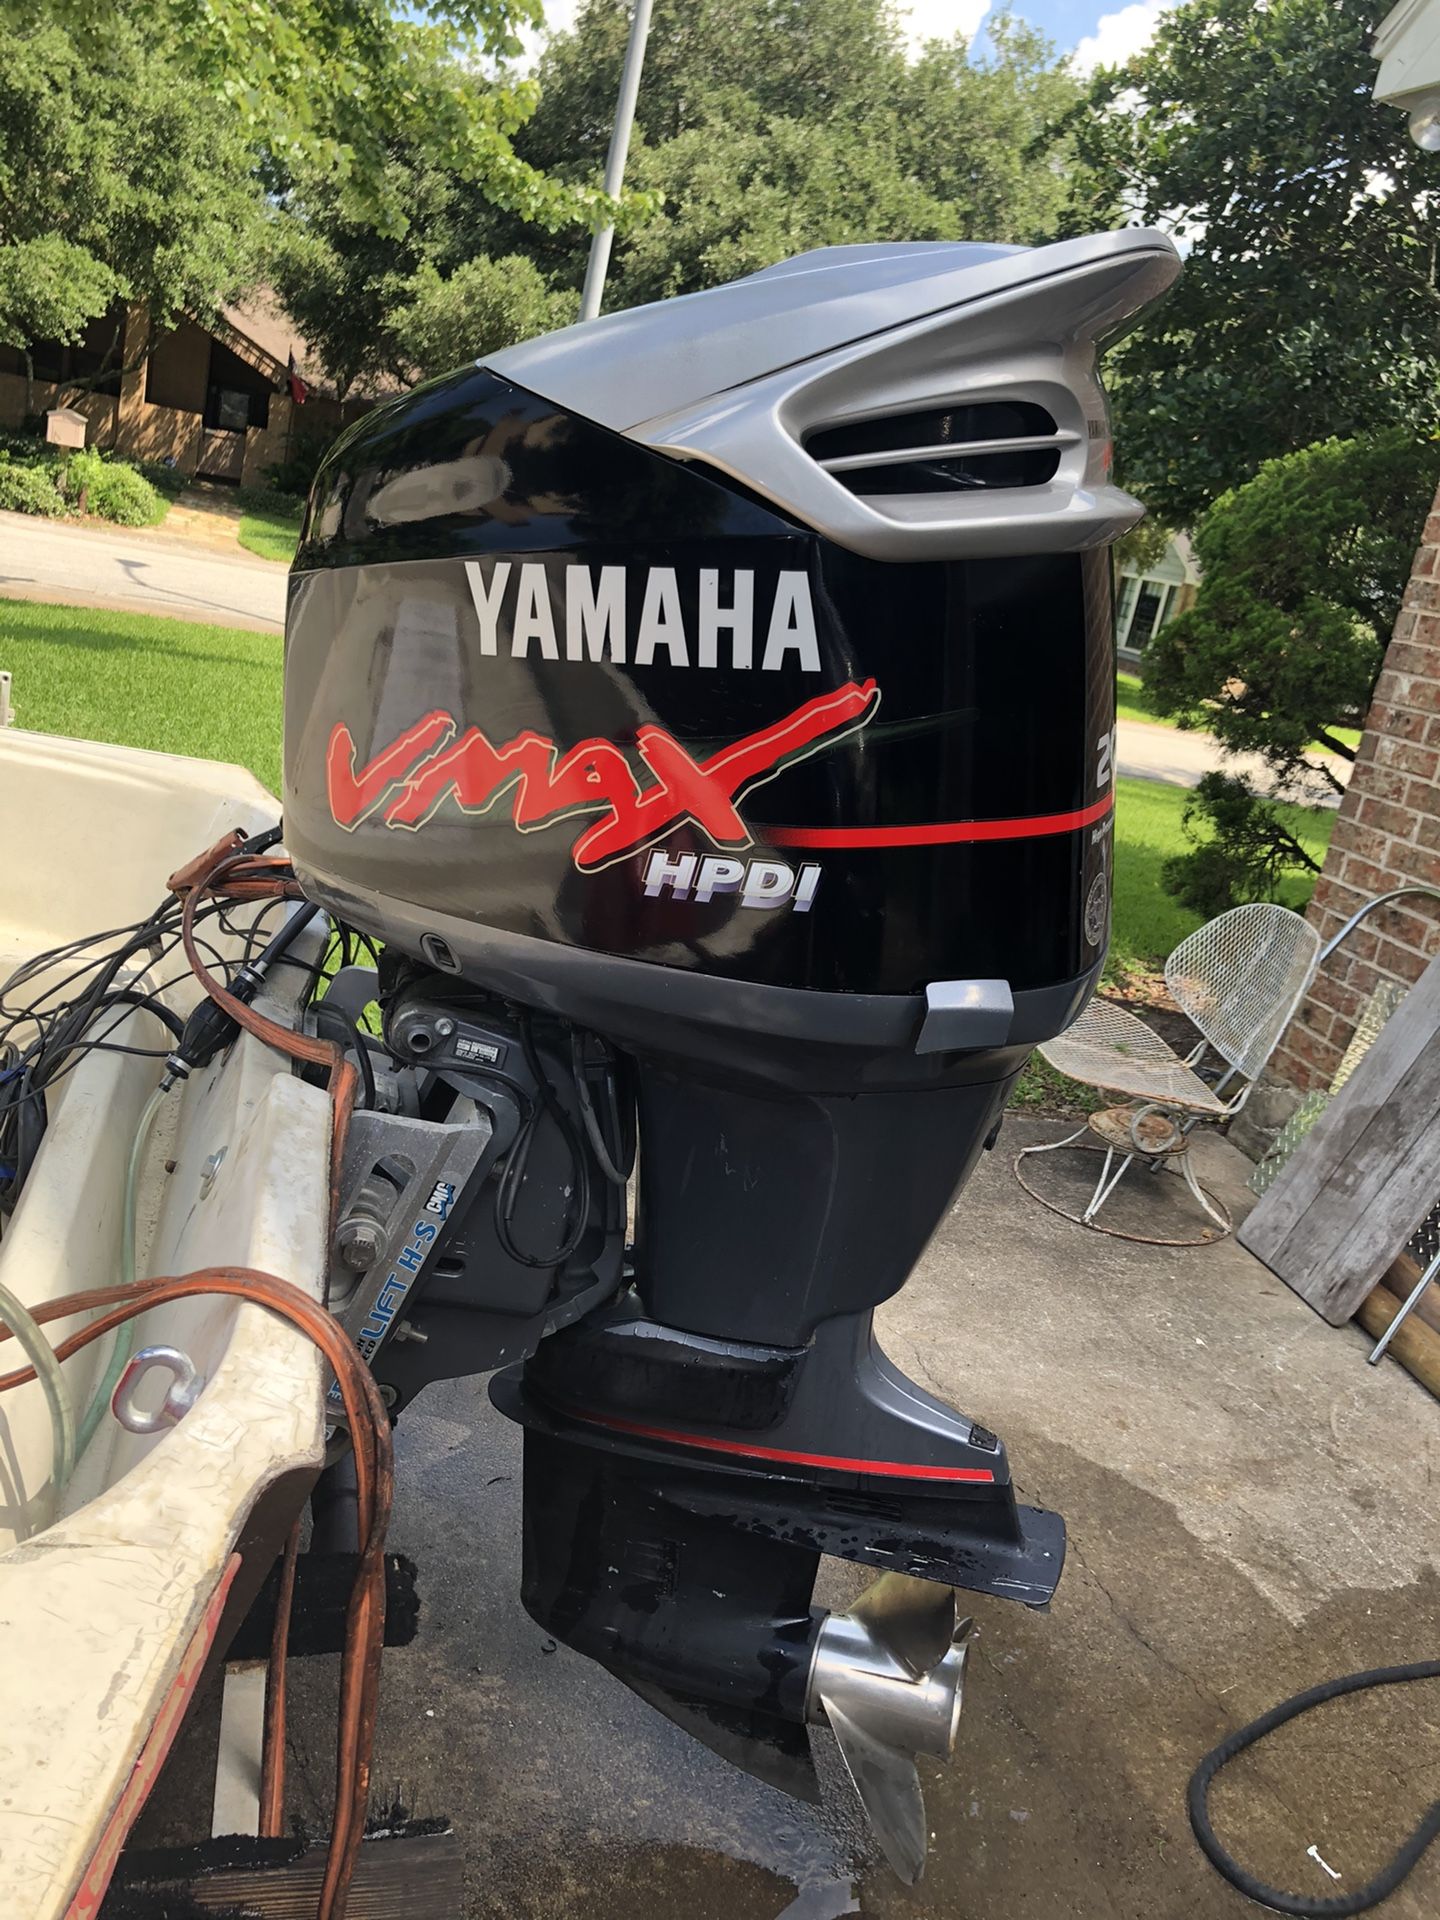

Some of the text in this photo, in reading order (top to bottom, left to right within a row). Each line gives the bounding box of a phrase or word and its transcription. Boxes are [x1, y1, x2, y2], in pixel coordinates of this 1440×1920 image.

[465, 562, 821, 673] YAMAHA
[642, 848, 822, 912] HPDI
[360, 1219, 437, 1339] LIFT H-S
[361, 1340, 376, 1360] EED
